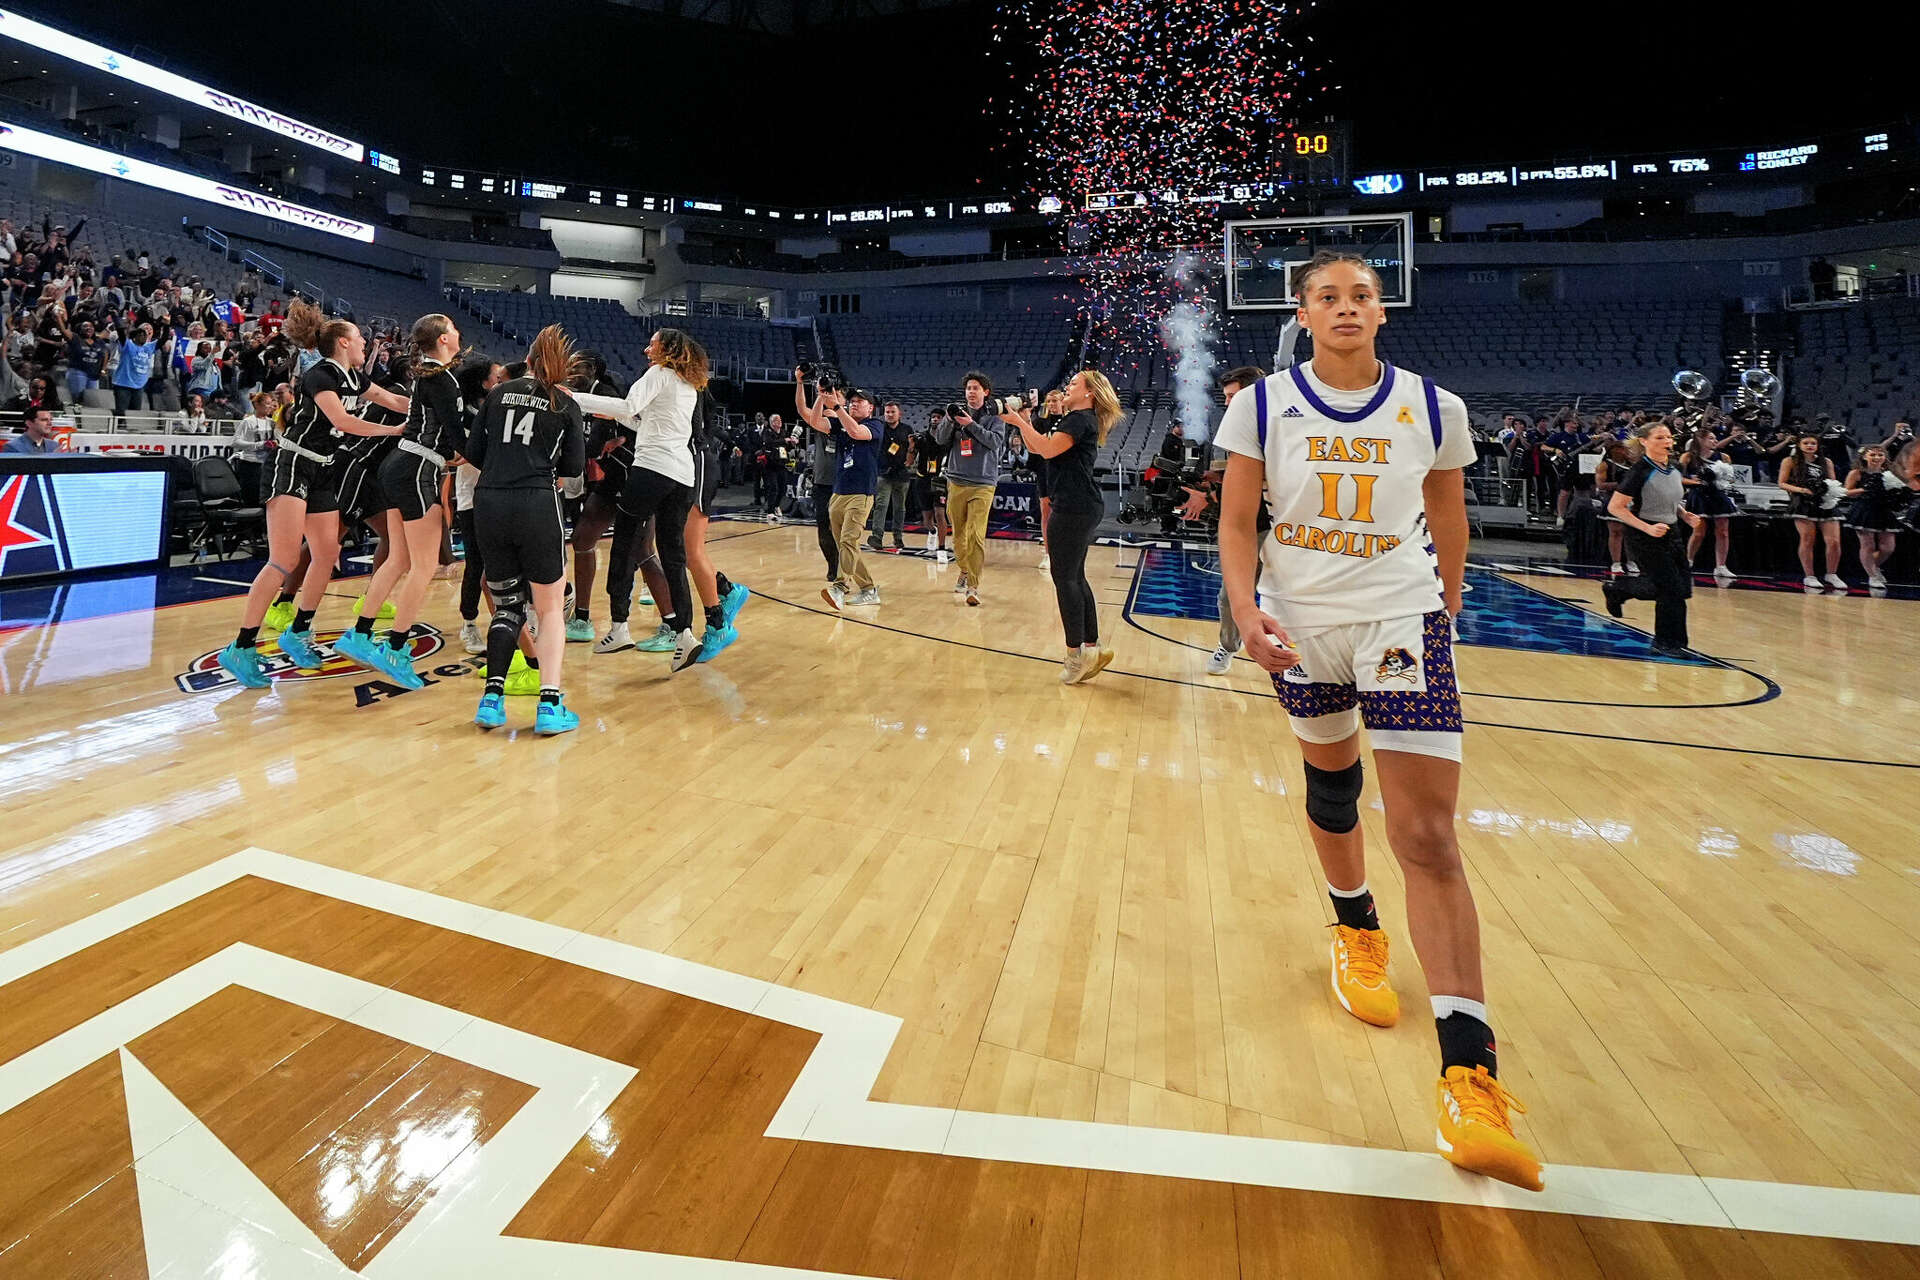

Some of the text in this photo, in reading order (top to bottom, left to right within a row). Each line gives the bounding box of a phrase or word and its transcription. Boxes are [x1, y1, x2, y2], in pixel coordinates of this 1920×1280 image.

[1865, 134, 1888, 144] PTS
[1745, 145, 1818, 161] 4 RICKARD
[1865, 143, 1889, 153] PTS
[1633, 158, 1709, 173] FT% 75%
[1739, 155, 1809, 171] 12 CONLEY
[1456, 171, 1508, 186] 38.2%
[1554, 165, 1609, 180] 55.6%
[984, 202, 1011, 214] 60%
[503, 408, 536, 446] 14
[1306, 436, 1392, 464] EAST
[1317, 472, 1379, 523] 11
[1275, 523, 1402, 559] CAROLIN
